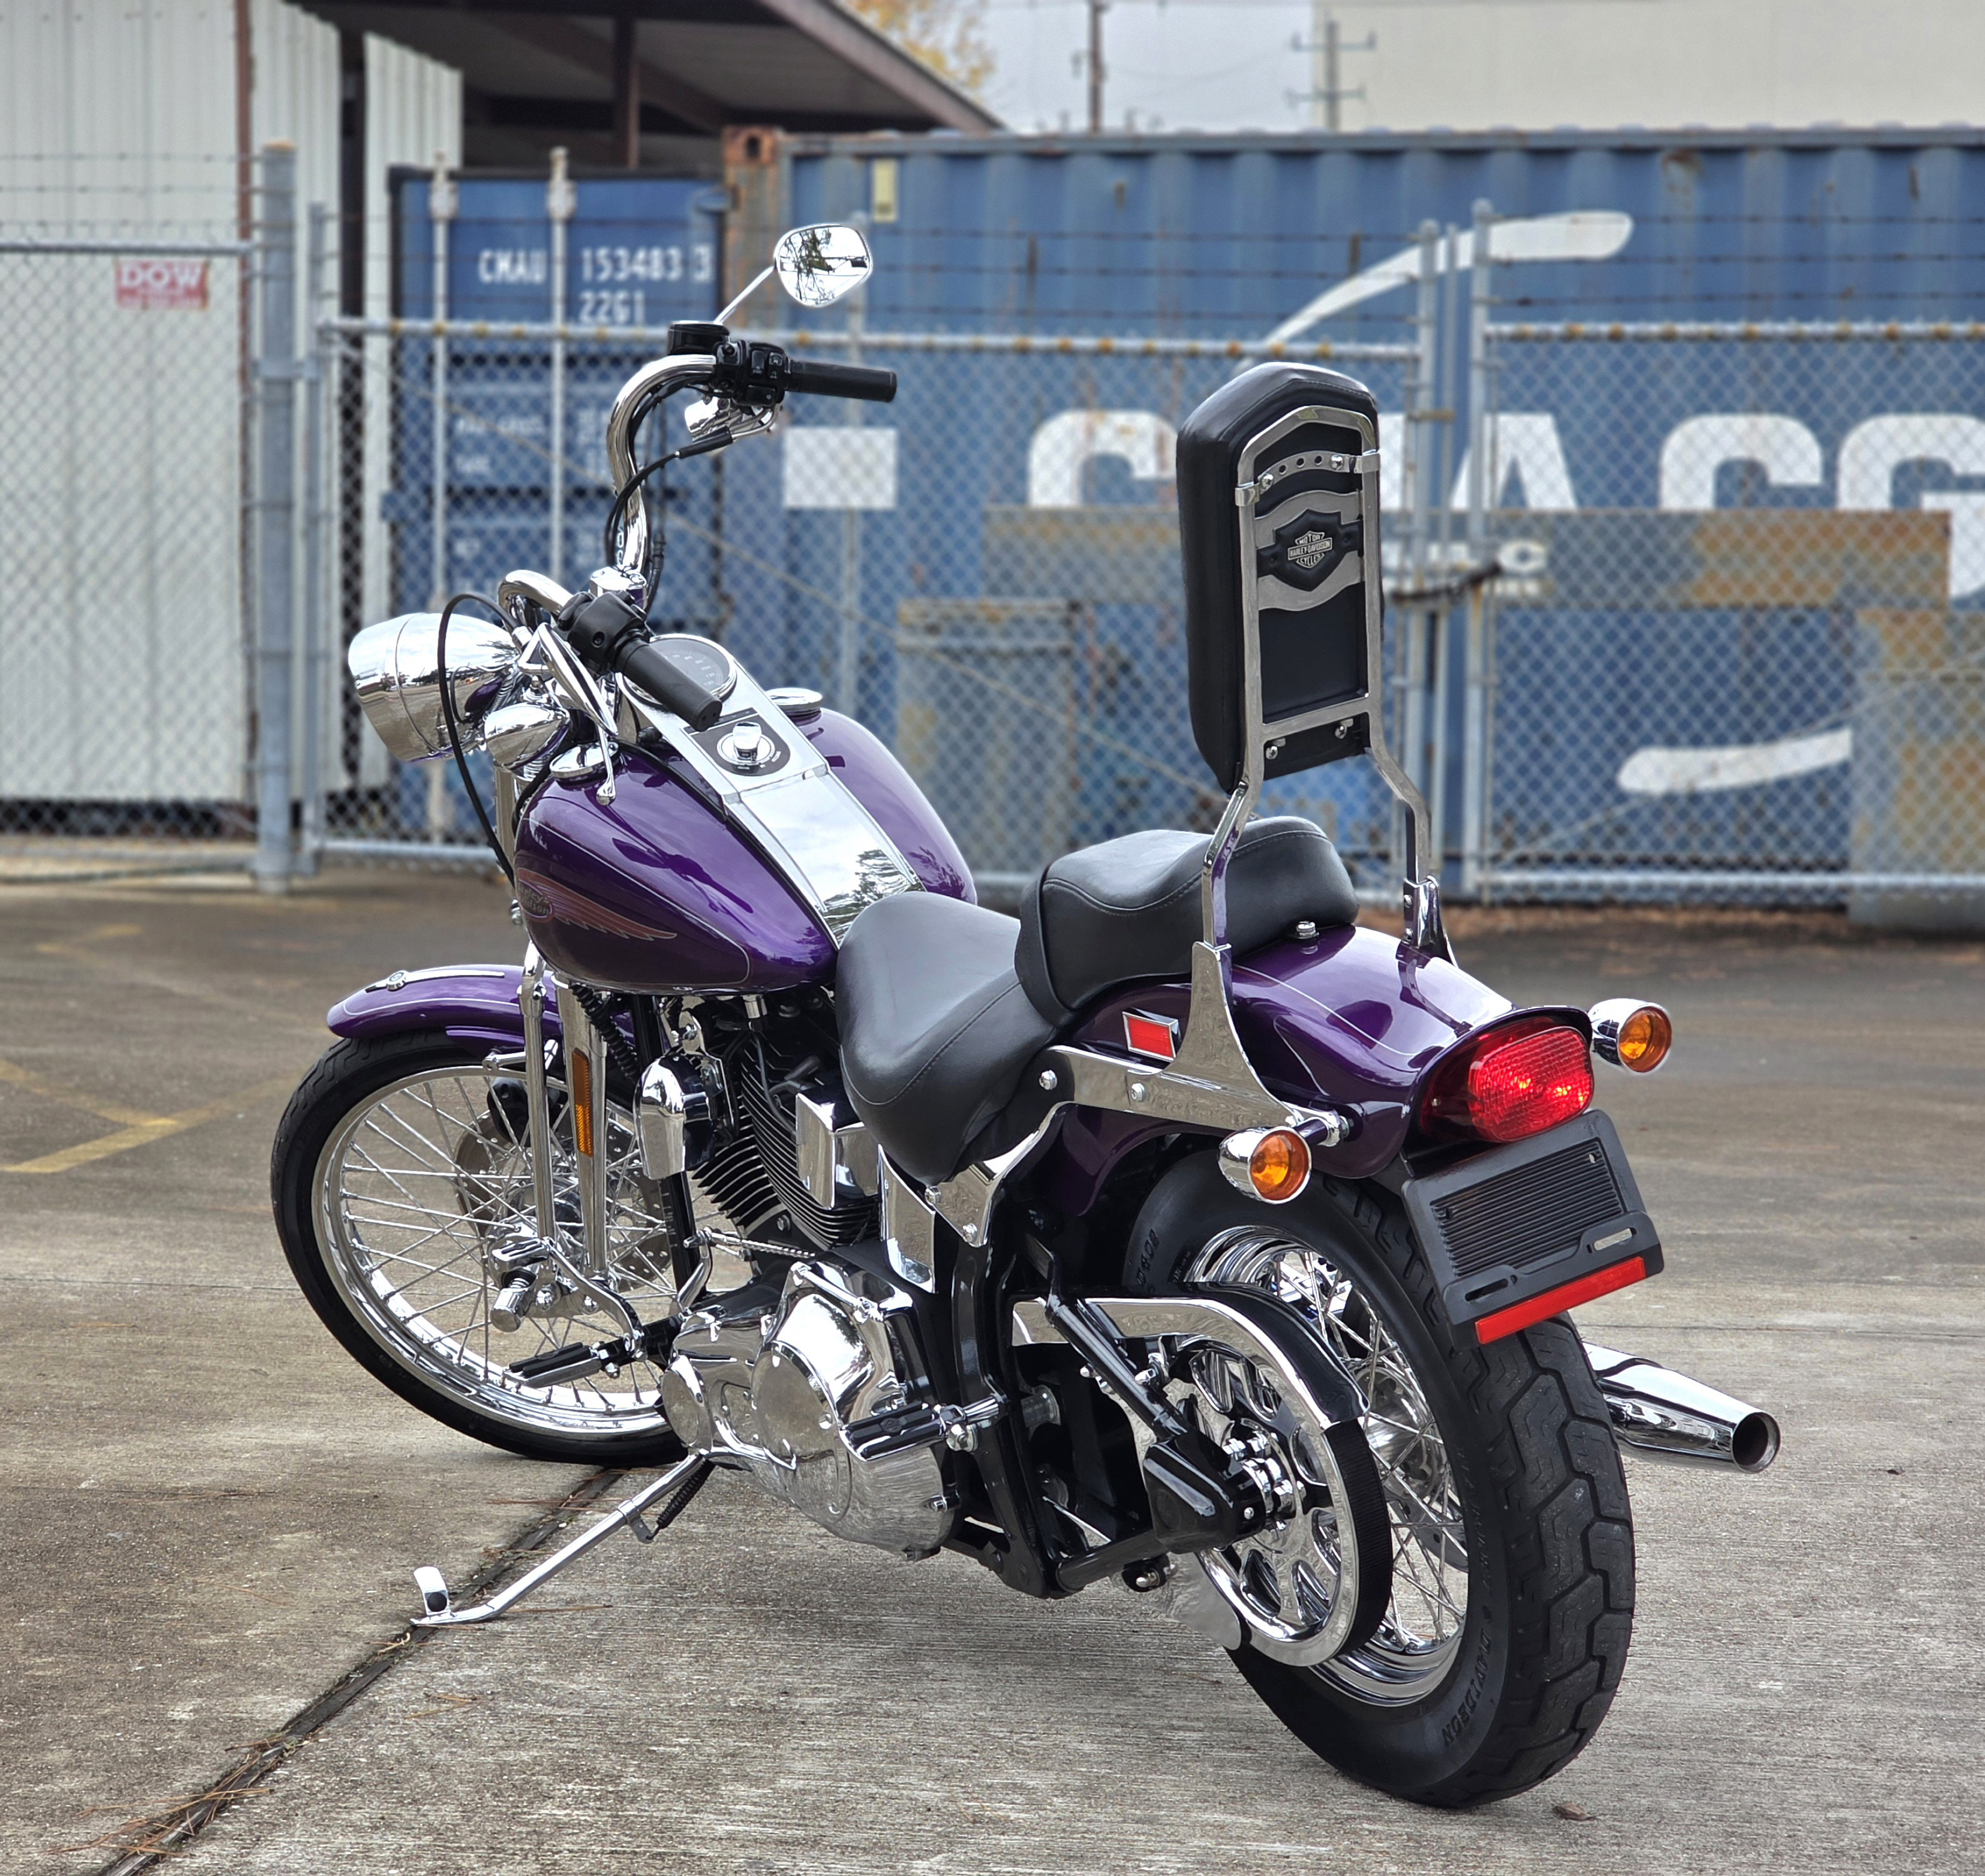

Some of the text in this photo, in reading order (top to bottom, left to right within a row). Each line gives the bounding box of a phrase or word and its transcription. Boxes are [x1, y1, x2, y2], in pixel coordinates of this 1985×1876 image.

[478, 245, 714, 283] CMAU 153483 3
[122, 263, 201, 289] DOW
[1290, 540, 1330, 558] HARLEY-DAVIDSON
[1299, 533, 1321, 544] MOTOR
[1300, 553, 1321, 566] CYCLES
[1442, 1627, 1492, 1745] DAVIDSON
